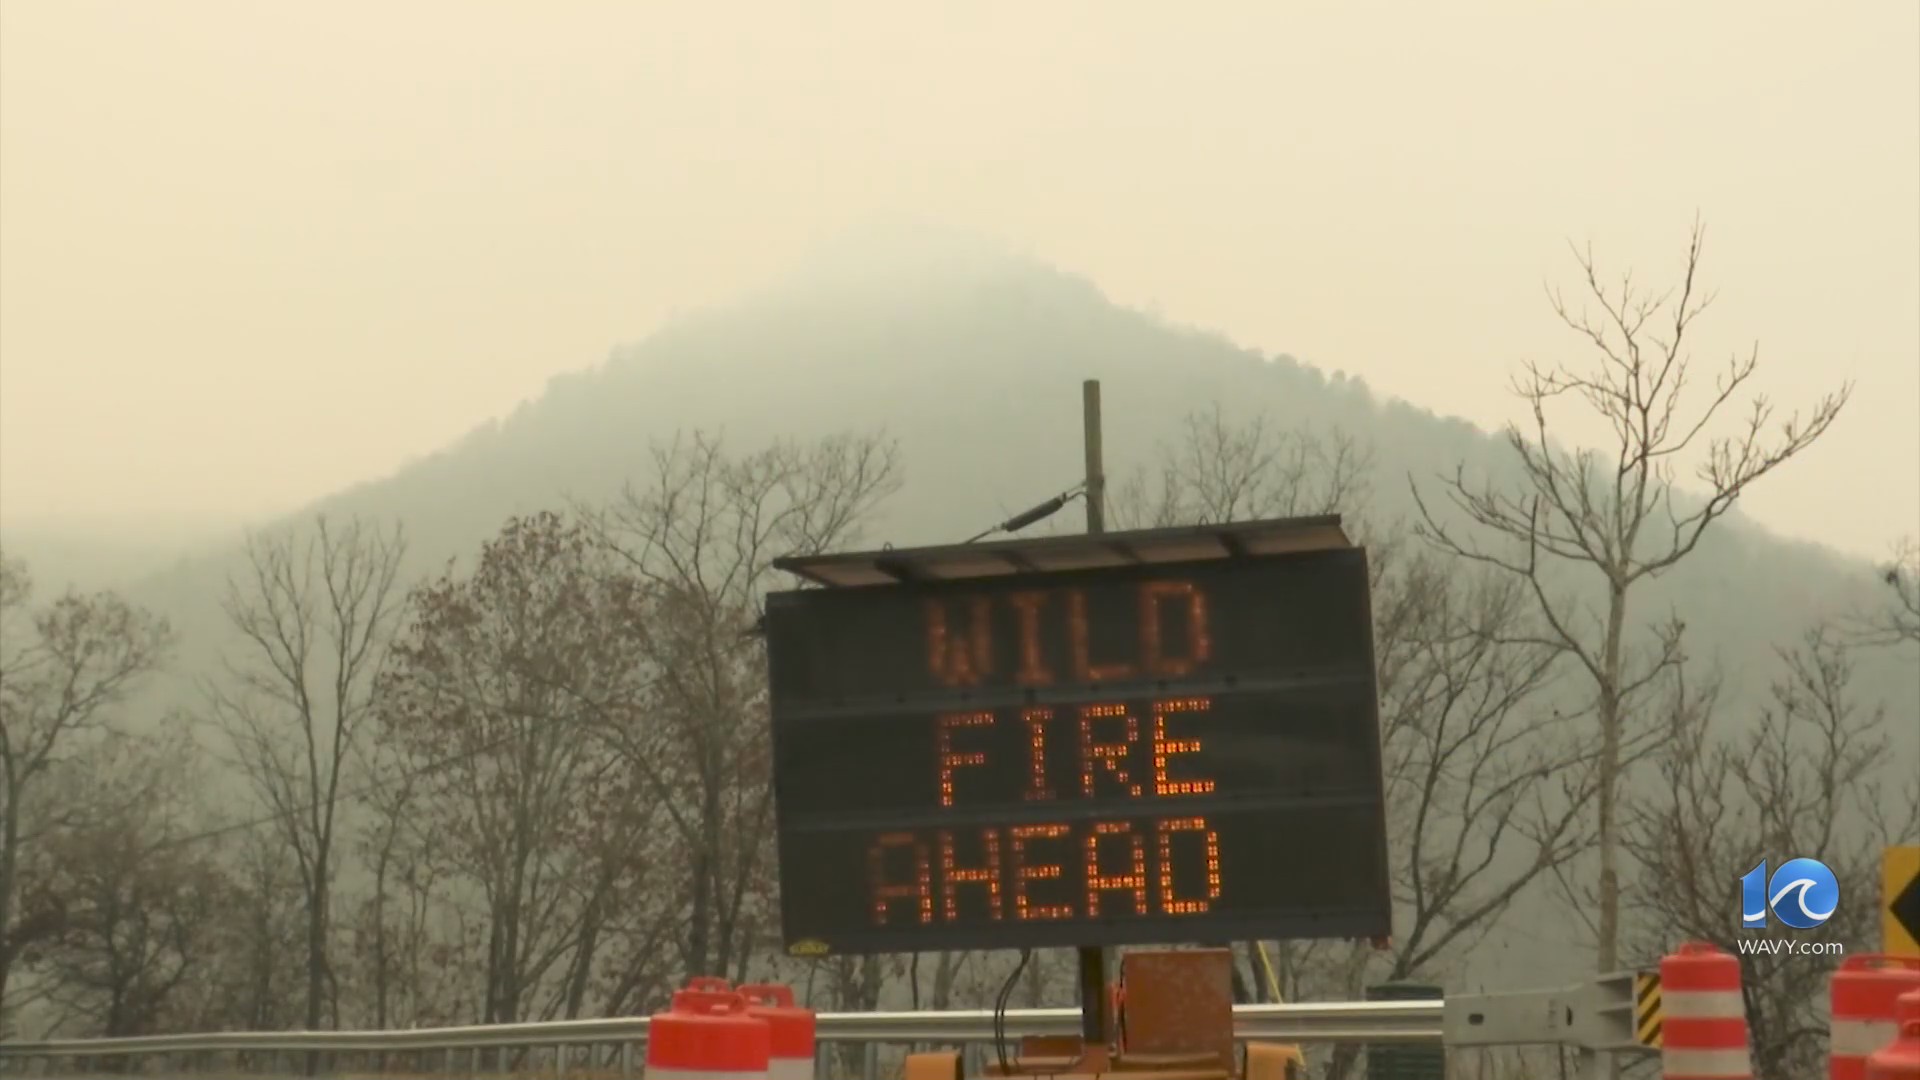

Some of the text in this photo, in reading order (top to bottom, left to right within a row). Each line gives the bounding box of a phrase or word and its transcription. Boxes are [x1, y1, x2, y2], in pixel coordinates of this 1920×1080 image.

[927, 581, 1212, 687] WILD
[939, 697, 1215, 807] FIRE
[868, 816, 1222, 925] AHEAD
